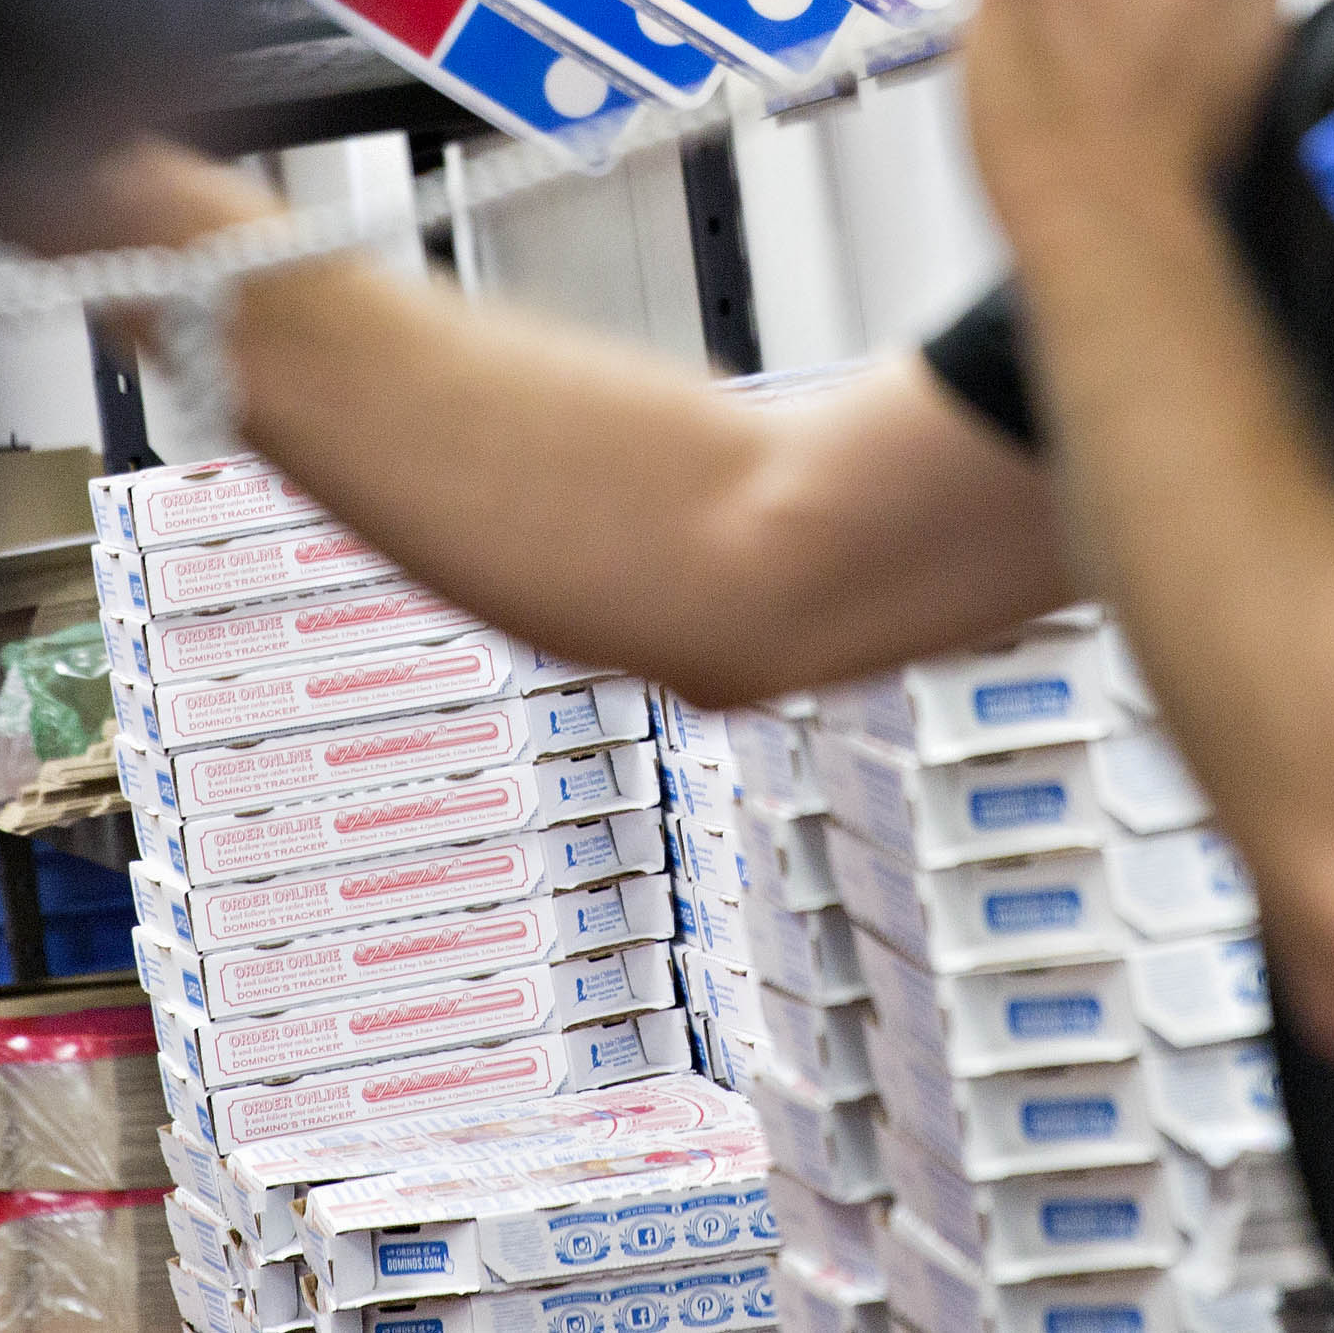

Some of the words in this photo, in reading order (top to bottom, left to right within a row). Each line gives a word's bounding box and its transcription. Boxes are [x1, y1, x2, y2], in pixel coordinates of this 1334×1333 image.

[163, 489, 211, 507] ORDER
[215, 479, 269, 499] ONLINE
[176, 556, 225, 575] ORDER
[229, 547, 283, 566] ONLINE
[177, 625, 226, 643] ORDER
[230, 616, 284, 634] ONLINE
[187, 691, 236, 709] ORDER
[240, 682, 293, 700] ONLINE
[206, 759, 255, 777] ORDER
[259, 749, 312, 768] ONLINE
[215, 827, 264, 846] ORDER
[268, 817, 322, 836] ONLINE
[221, 893, 270, 911] ORDER
[274, 883, 327, 902] ONLINE
[235, 959, 284, 978] ORDER
[288, 949, 341, 969] ONLINE
[230, 1028, 279, 1047] ORDER
[283, 1018, 337, 1037] ONLINE
[243, 1096, 292, 1115] ORDER
[296, 1086, 350, 1105] ONLINE
[387, 1255, 442, 1271] DOMINOS.COM
